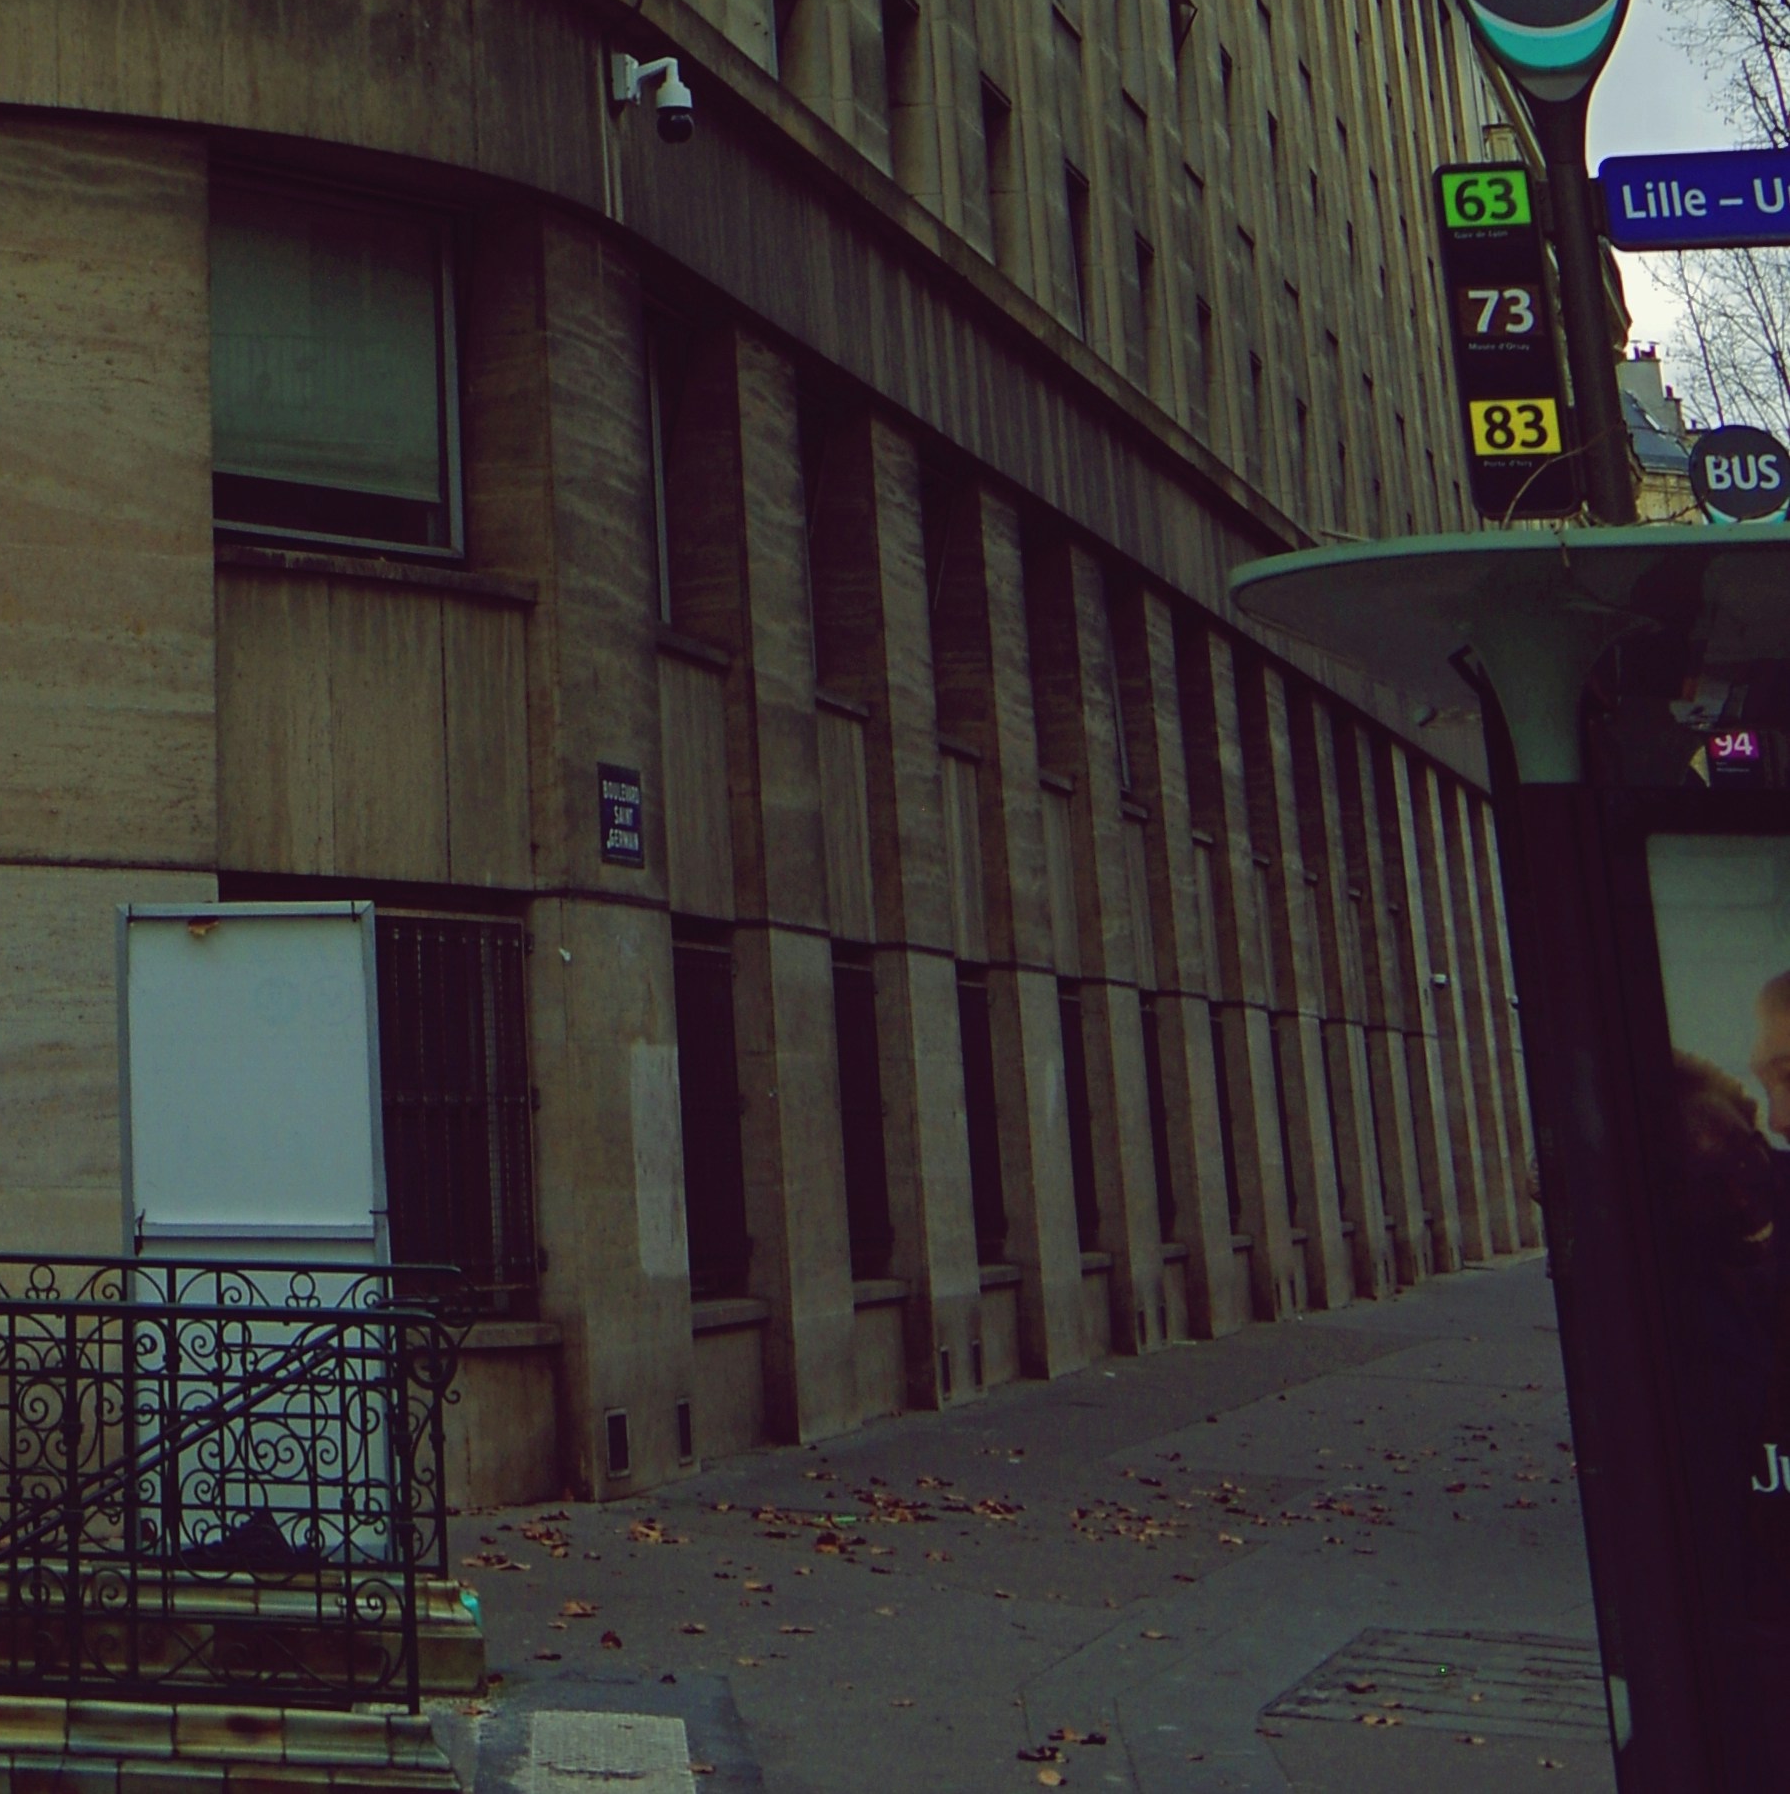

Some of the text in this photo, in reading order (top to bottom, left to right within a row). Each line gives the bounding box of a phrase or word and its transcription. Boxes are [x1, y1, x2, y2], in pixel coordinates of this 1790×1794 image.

[1454, 177, 1518, 223] 63
[1621, 180, 1707, 220] Lille
[1752, 176, 1790, 214] U
[1467, 288, 1535, 334] 73
[1483, 404, 1549, 449] 83
[1704, 453, 1781, 491] BUS
[1714, 732, 1754, 757] 94
[602, 780, 640, 804] BOULEVARD
[613, 805, 633, 826] SAINT
[606, 829, 639, 851] GERMAIN
